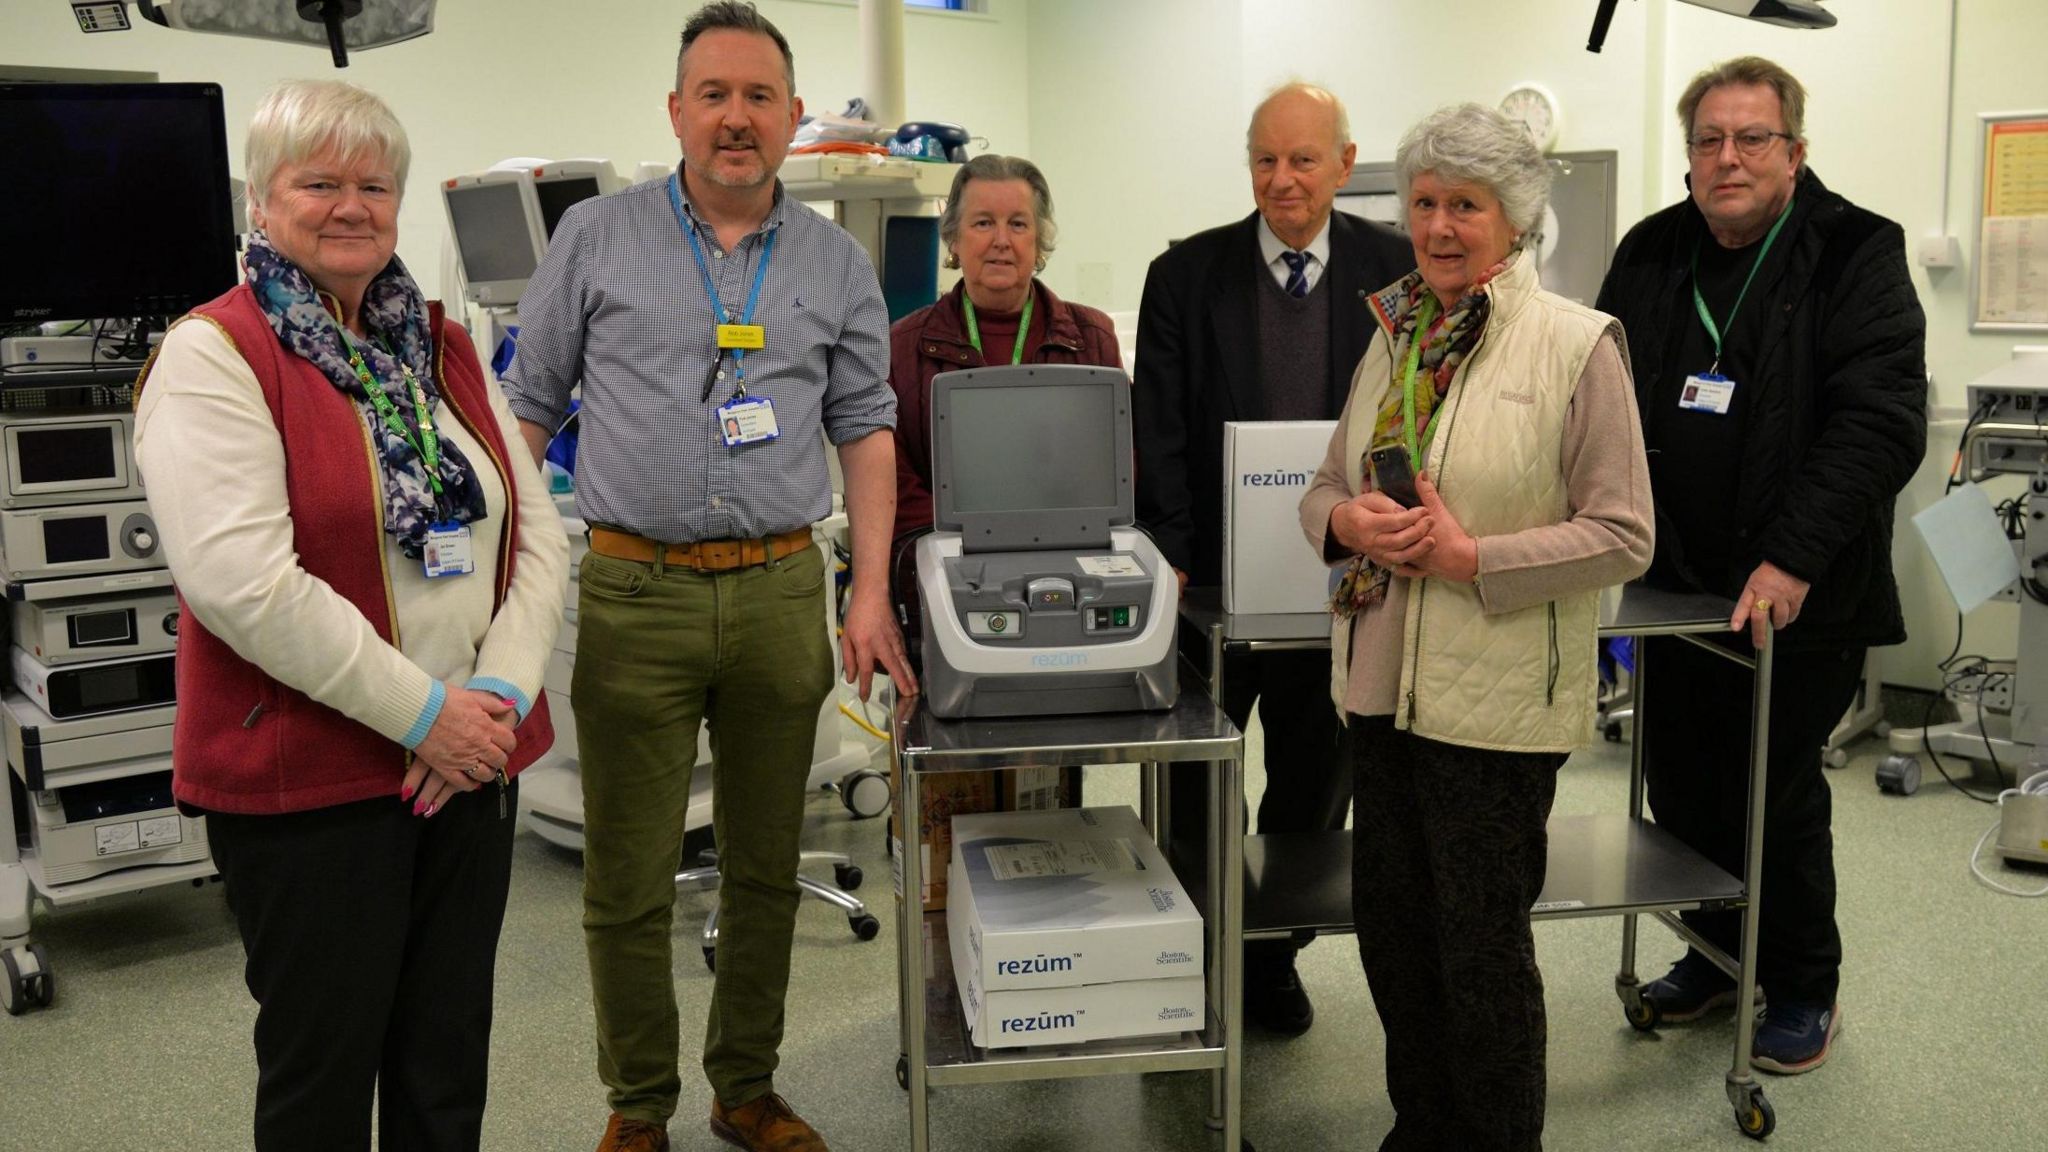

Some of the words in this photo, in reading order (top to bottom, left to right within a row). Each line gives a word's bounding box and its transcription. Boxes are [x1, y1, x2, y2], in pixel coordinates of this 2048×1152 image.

[14, 308, 52, 318] stryker
[1156, 955, 1194, 965] Scientific
[1158, 1010, 1196, 1020] Scientific
